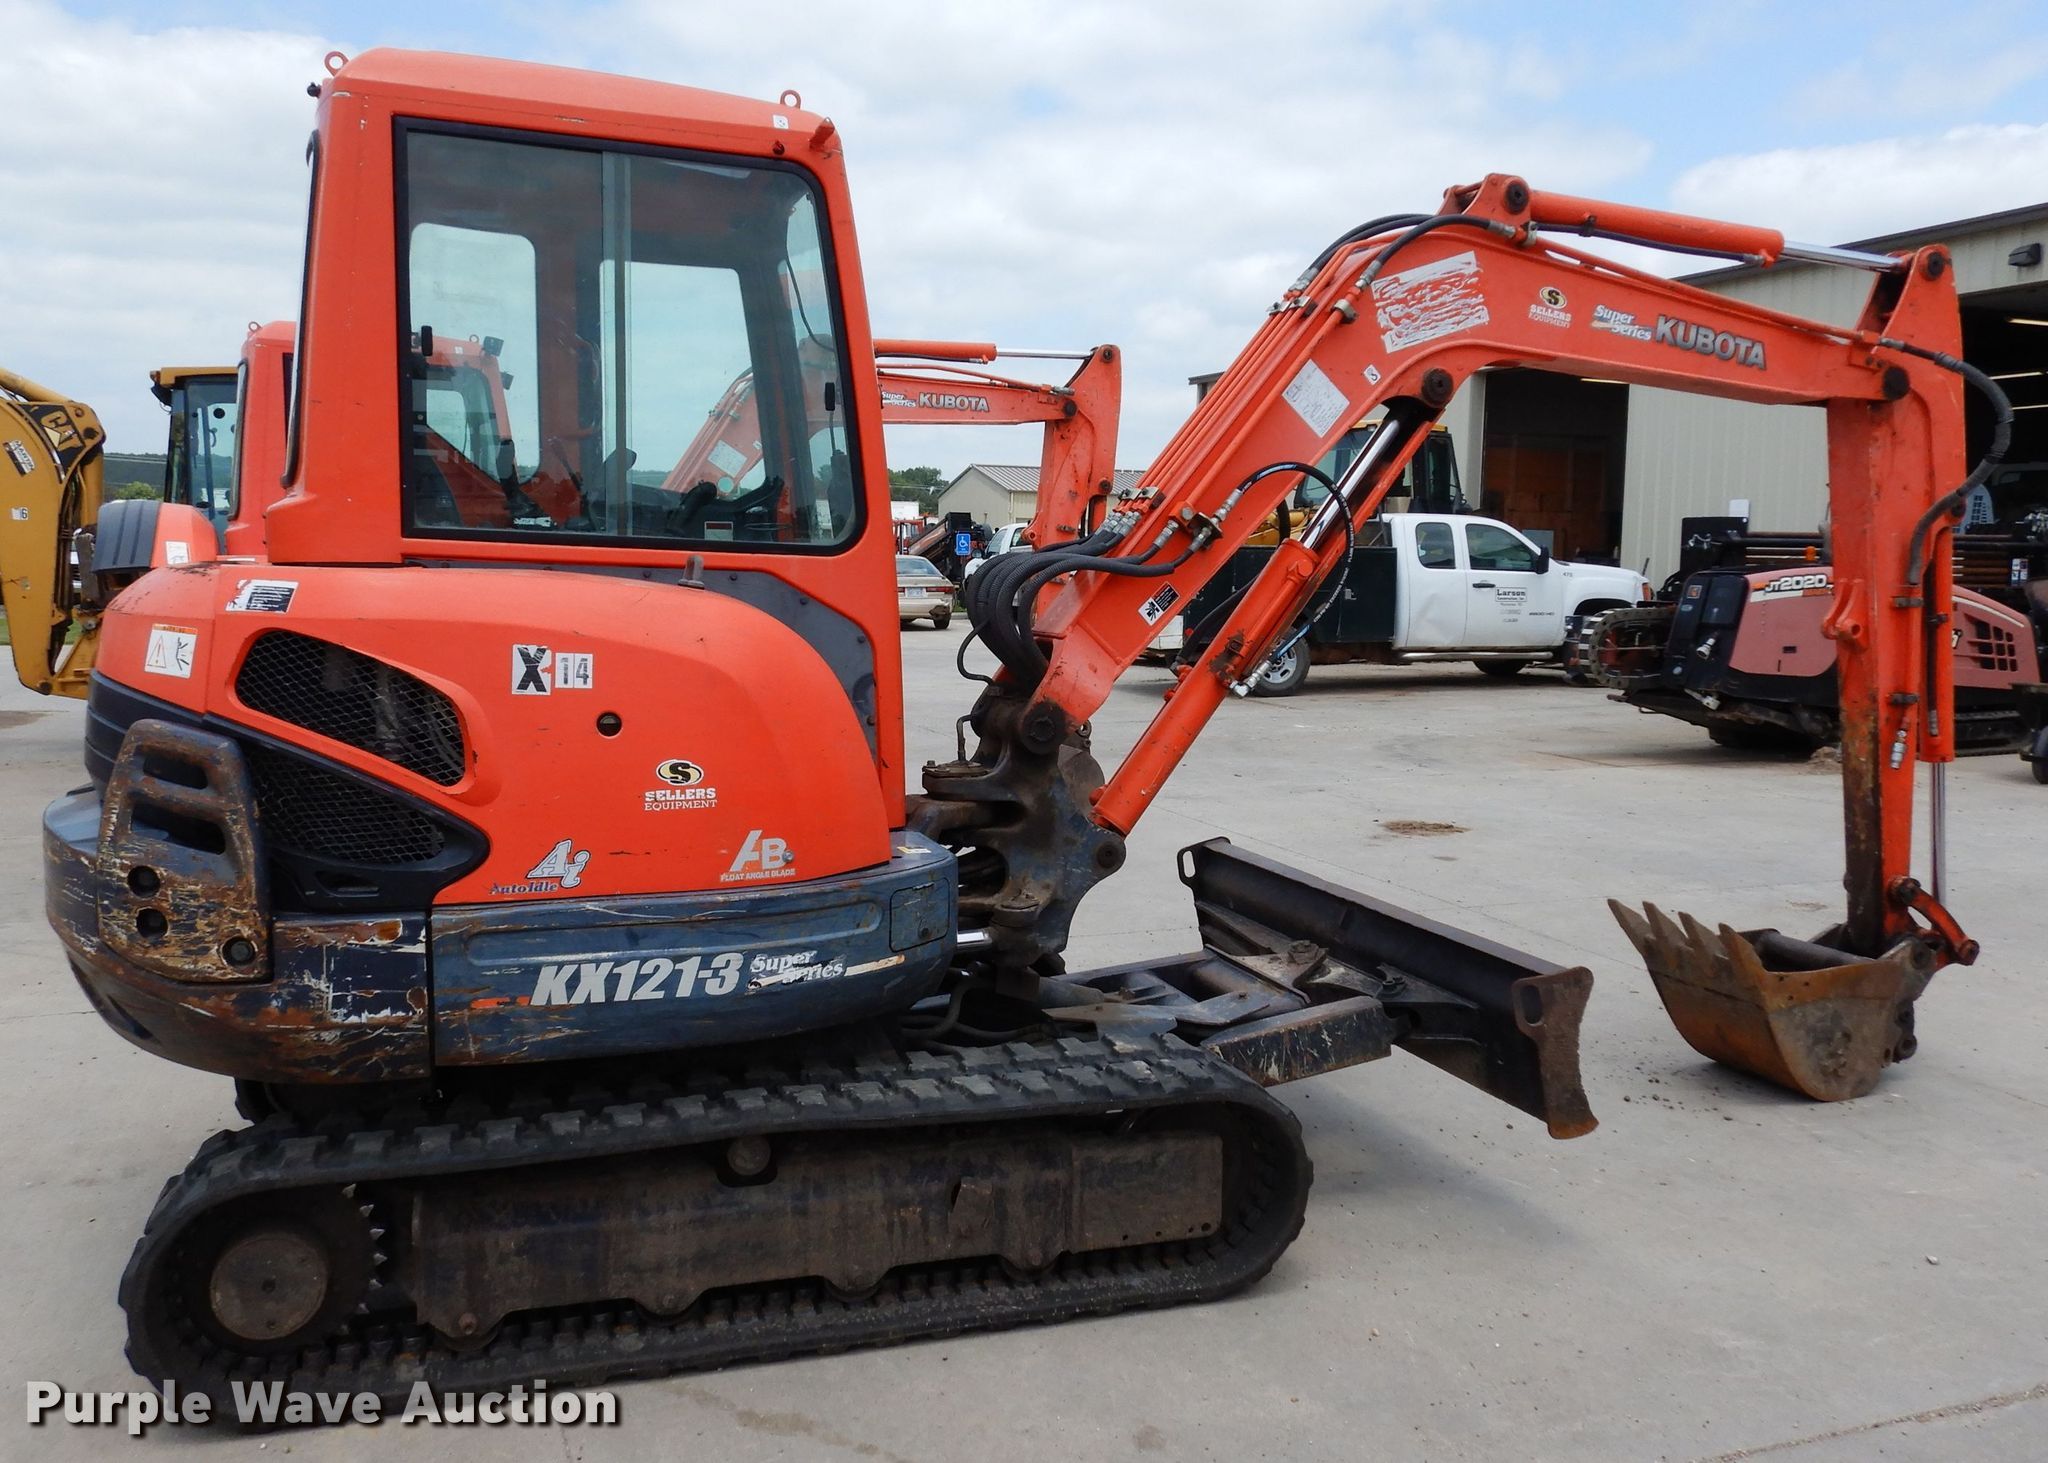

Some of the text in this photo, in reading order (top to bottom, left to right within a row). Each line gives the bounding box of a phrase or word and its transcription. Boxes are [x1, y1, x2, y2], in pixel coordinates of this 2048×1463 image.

[1529, 304, 1572, 321] SELLERS
[1594, 304, 1635, 324] Super
[1610, 321, 1652, 341] Series
[1656, 314, 1767, 370] KUBOTA
[919, 392, 990, 412] KUBOTA
[40, 410, 86, 451] CAT
[1764, 574, 1827, 592] JT2020
[516, 646, 589, 693] X 14
[645, 787, 717, 802] SELLERS
[644, 799, 718, 811] EQUIPMENT
[720, 872, 744, 882] FLOAT
[750, 950, 818, 973] Super
[530, 952, 743, 1006] KX121-3
